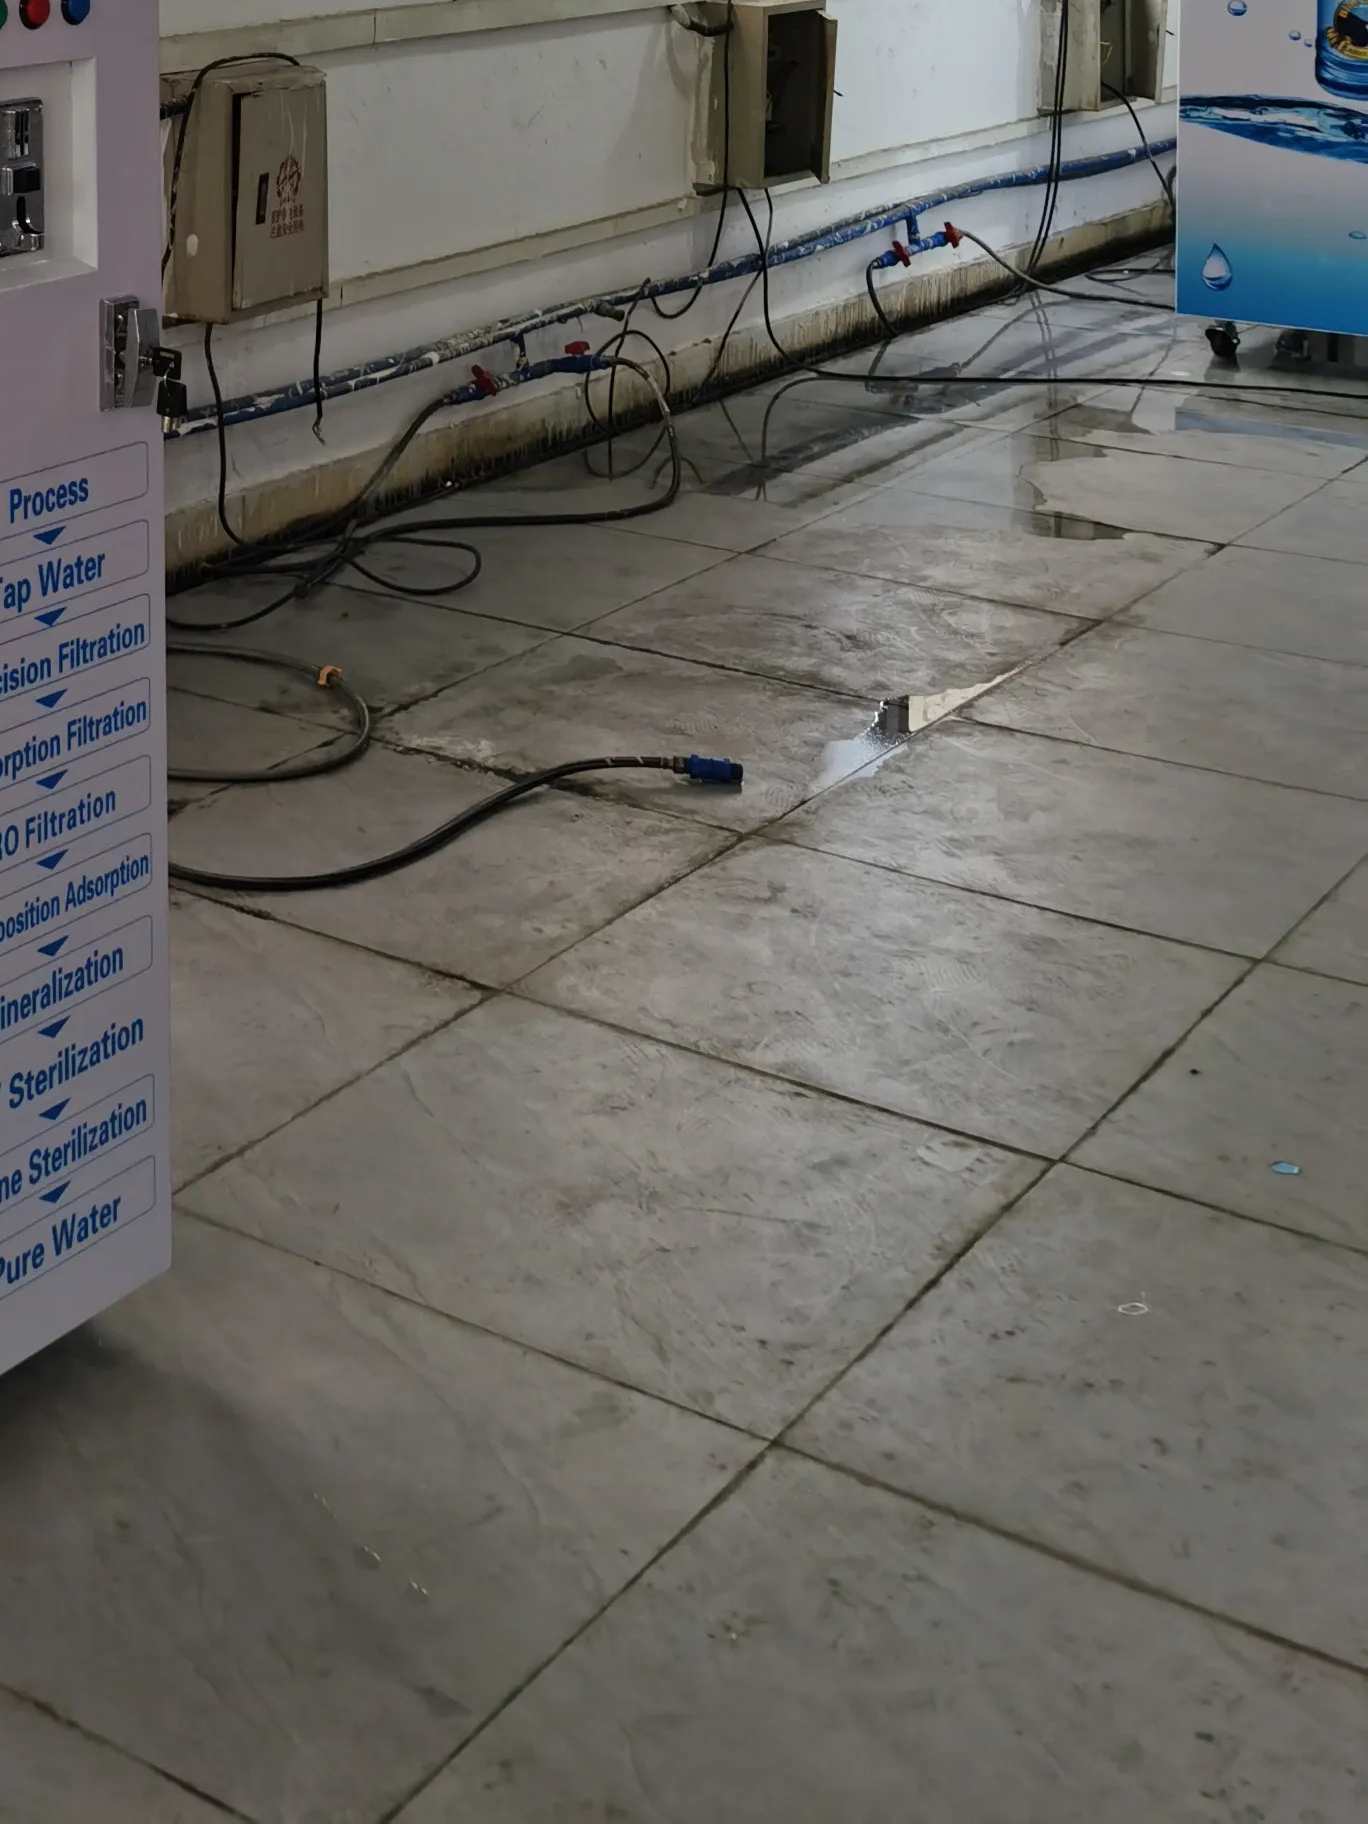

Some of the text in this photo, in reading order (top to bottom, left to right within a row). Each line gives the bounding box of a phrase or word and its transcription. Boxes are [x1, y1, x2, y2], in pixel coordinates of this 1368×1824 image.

[9, 477, 89, 524] Process
[38, 552, 106, 597] Water
[58, 620, 145, 675] Filtration
[66, 698, 147, 752] Filtration
[25, 788, 117, 849] Filtration
[65, 851, 150, 909] Adsorption
[9, 1016, 145, 1110] Sterilization
[28, 1097, 148, 1187] Sterilization
[52, 1195, 122, 1256] Water
